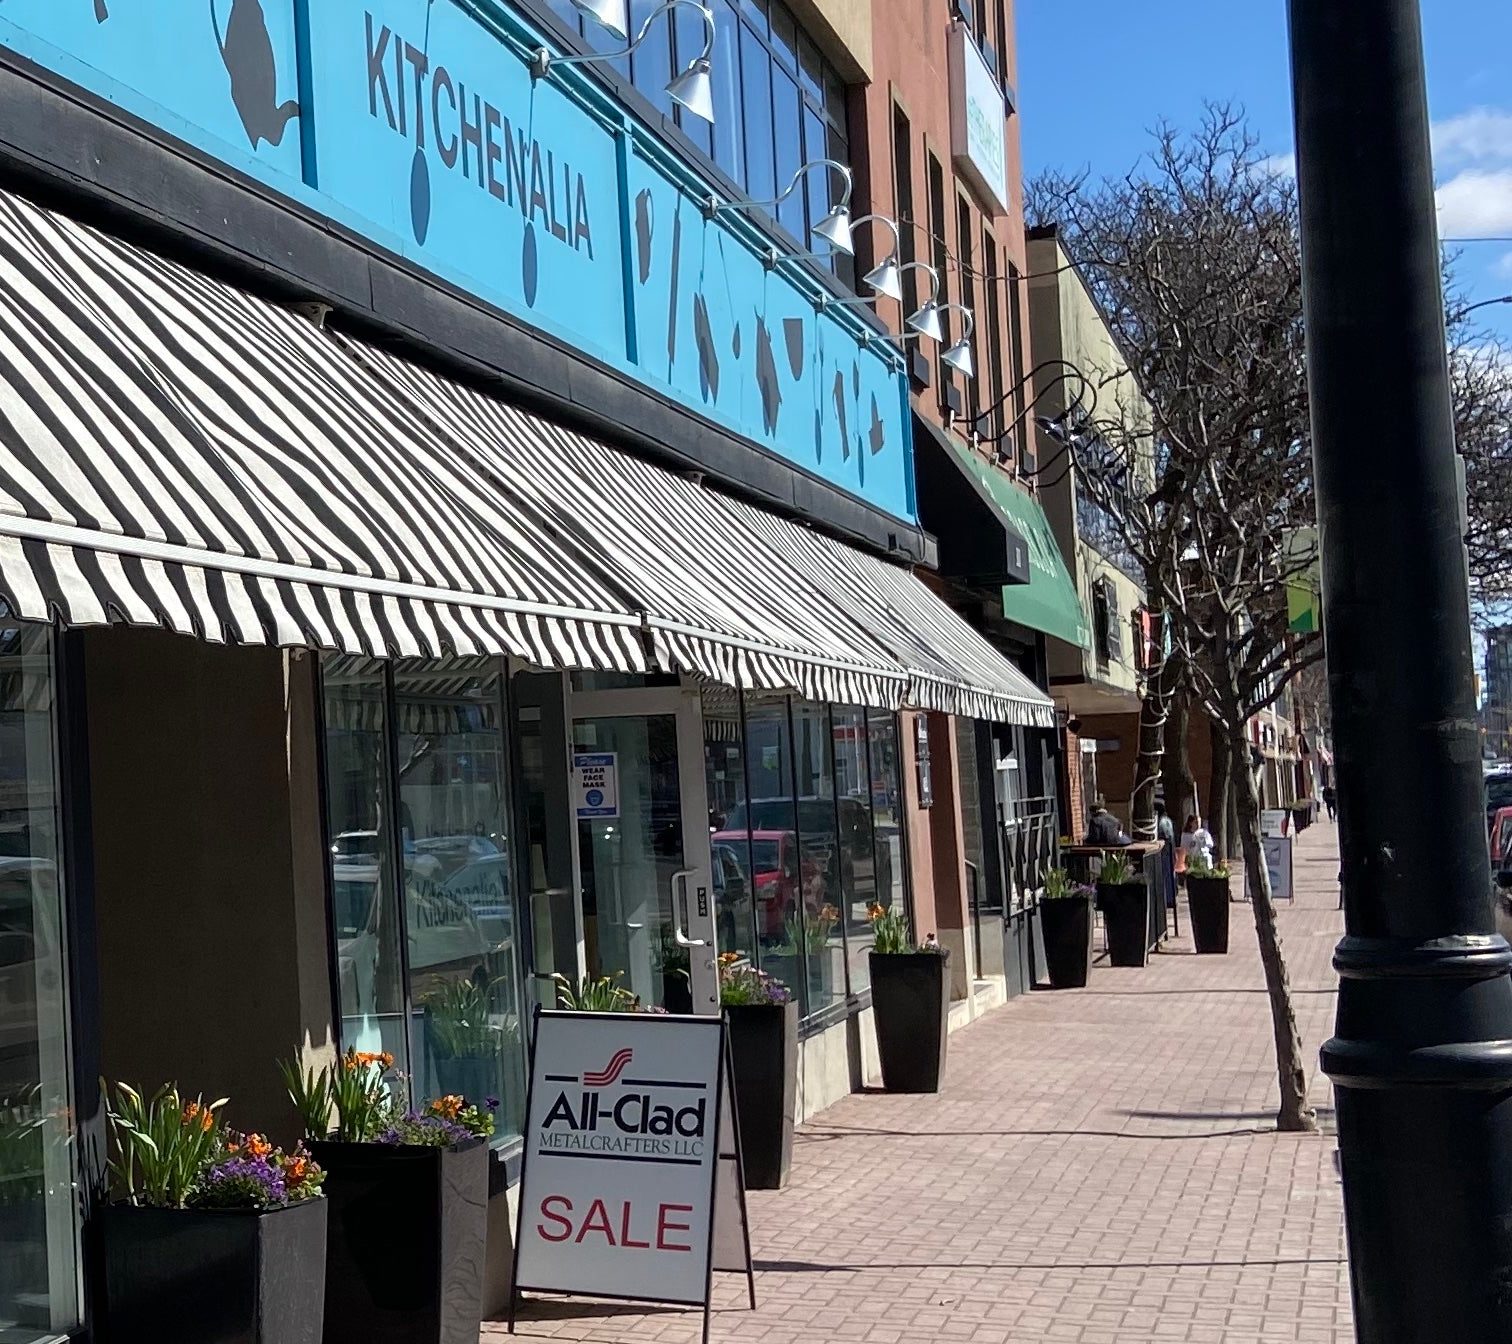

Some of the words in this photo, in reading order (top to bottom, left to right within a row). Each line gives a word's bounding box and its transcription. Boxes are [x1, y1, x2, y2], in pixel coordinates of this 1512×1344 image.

[364, 9, 594, 262] KITCHENALIA
[541, 1090, 707, 1138] All-Clad
[538, 1131, 671, 1154] METALCRAFTERS
[674, 1139, 704, 1157] LLC
[537, 1194, 694, 1252] SALE
